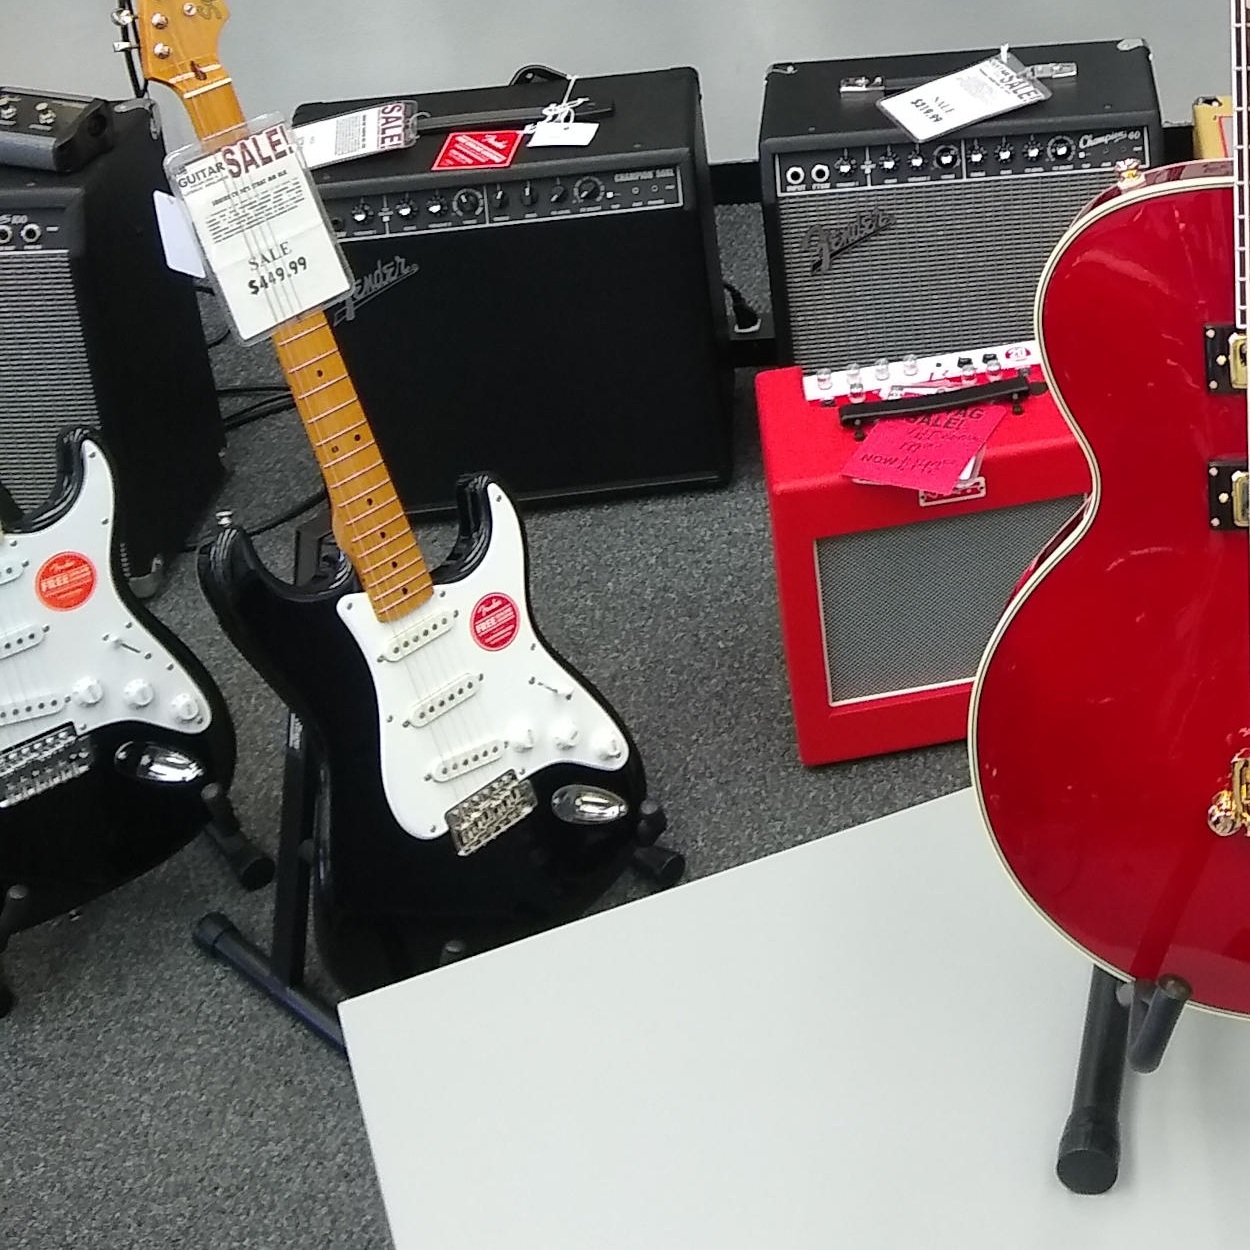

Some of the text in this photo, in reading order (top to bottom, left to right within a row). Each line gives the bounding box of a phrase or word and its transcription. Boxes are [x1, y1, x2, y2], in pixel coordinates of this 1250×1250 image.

[1000, 74, 1042, 102] SALE!
[379, 103, 402, 149] SALE!
[1079, 130, 1127, 149] Champion
[222, 125, 294, 179] SALE!
[178, 162, 226, 188] GUITAR
[614, 169, 653, 183] CHAMPION
[801, 206, 894, 274] Fender
[248, 241, 292, 271] SALE
[248, 256, 307, 295] $449.99
[861, 453, 899, 466] NOW
